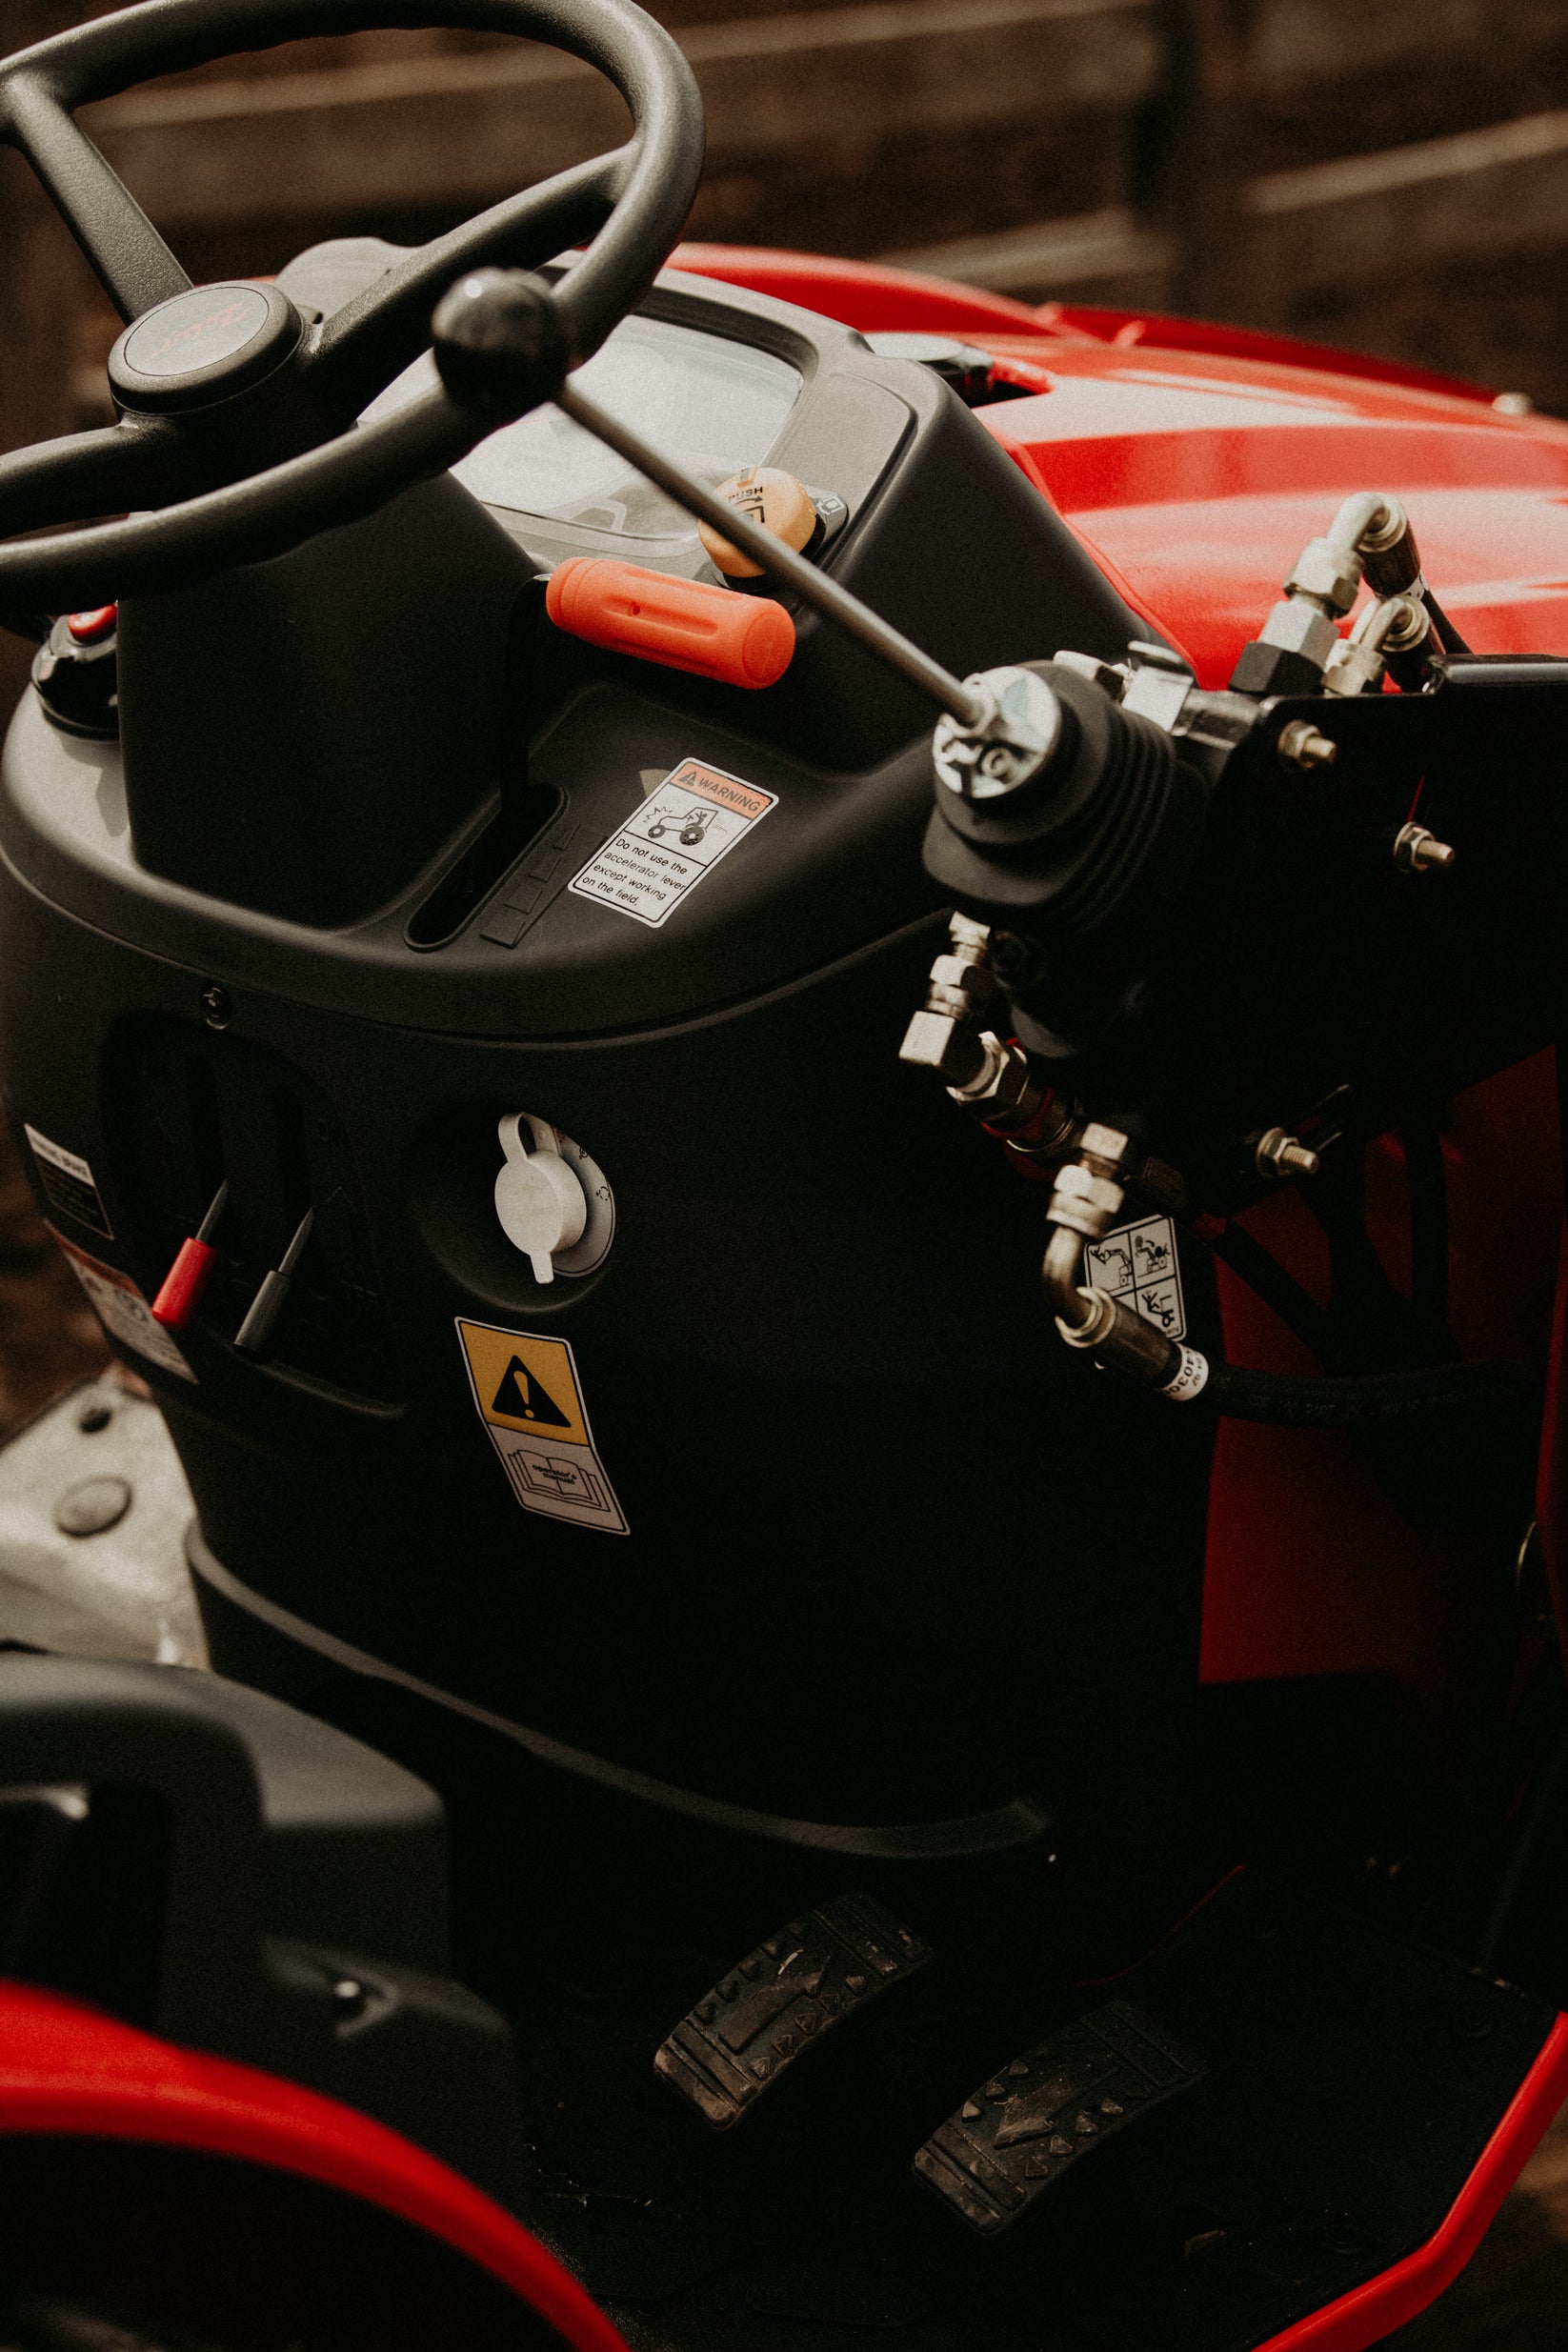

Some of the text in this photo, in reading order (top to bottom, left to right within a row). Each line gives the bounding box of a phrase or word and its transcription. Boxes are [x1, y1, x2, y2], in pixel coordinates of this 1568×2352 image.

[697, 777, 761, 813] WARNING
[604, 852, 686, 892] accelerator lever
[615, 837, 688, 875] Do not use the
[582, 876, 638, 906] on the field.
[593, 864, 667, 901] except working
